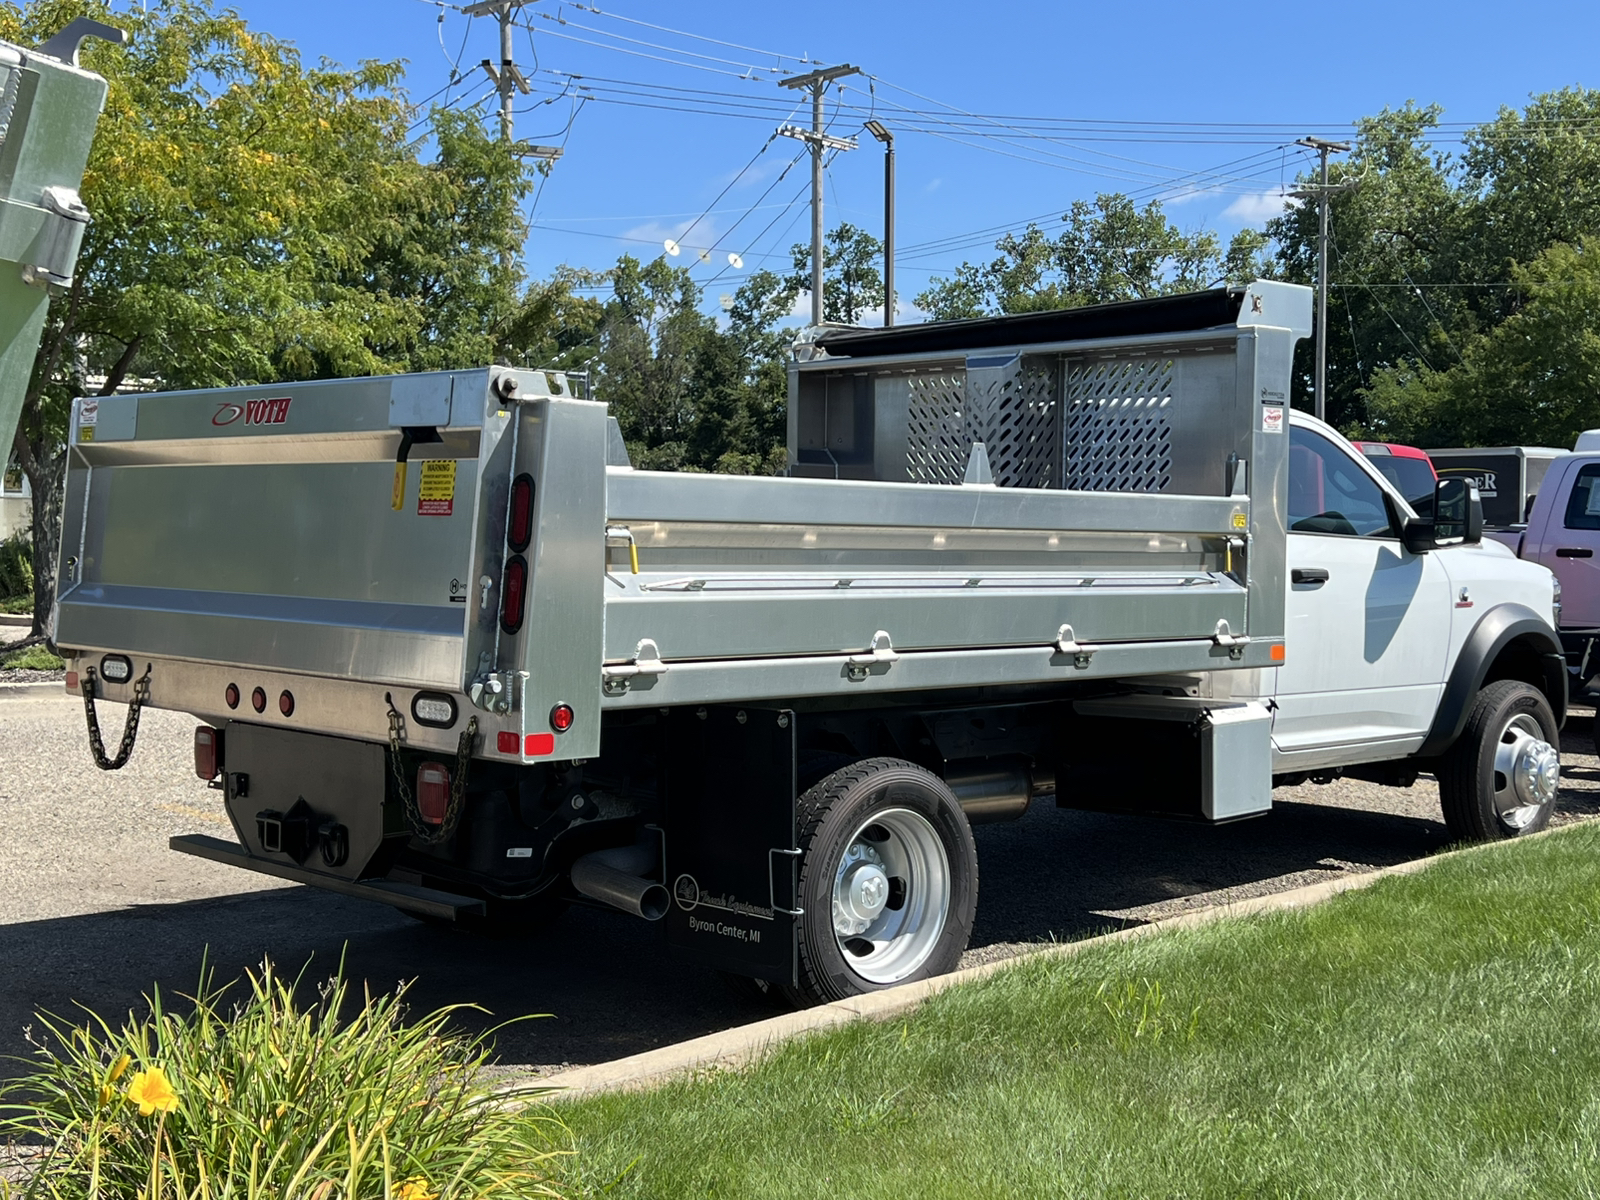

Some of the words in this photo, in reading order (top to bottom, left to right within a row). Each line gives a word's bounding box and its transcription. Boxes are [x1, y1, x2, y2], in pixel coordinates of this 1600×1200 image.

[244, 397, 292, 426] VOTH
[427, 464, 450, 472] WARNING
[727, 895, 775, 917] Equipment
[689, 915, 715, 933] Byron
[716, 922, 748, 943] Center,
[749, 929, 761, 944] MI
